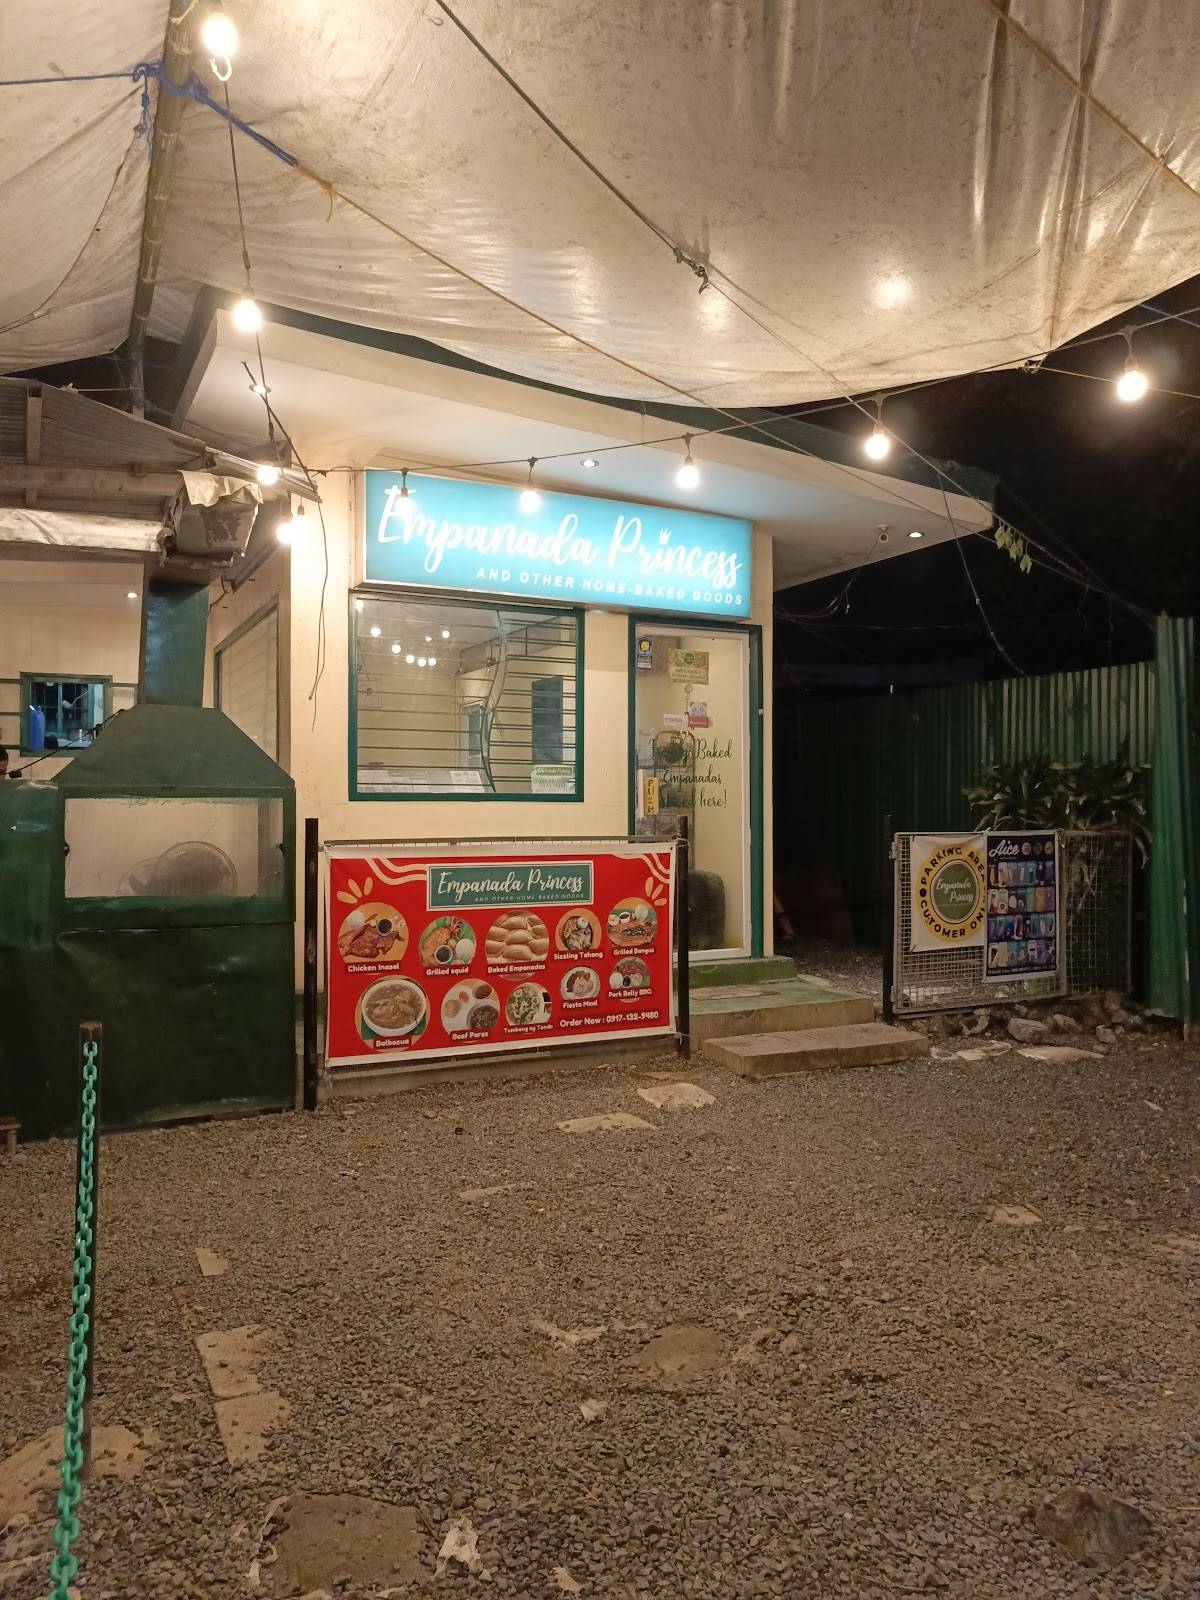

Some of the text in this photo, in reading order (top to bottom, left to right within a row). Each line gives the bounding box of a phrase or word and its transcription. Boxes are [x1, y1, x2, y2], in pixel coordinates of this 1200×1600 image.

[378, 485, 742, 589] Empanada Princess
[476, 567, 743, 605] AND OTHER HOME-BAKED GOODS
[696, 738, 732, 760] Baked
[663, 763, 721, 792] Empanadas
[700, 787, 727, 808] here!
[989, 839, 1019, 857] Aice
[920, 847, 962, 885] PARKING
[438, 868, 584, 903] Empanada Princess
[920, 900, 966, 938] CUTOMER
[553, 951, 603, 960] Sizzling Tahong
[613, 948, 633, 956] Grilled
[347, 963, 400, 973] Chicken Inasal
[426, 967, 469, 976] Grilled squid
[488, 964, 546, 974] Baked Empanadas
[560, 1018, 584, 1028] Order
[584, 1016, 601, 1025] Now
[452, 1031, 469, 1040] Beef
